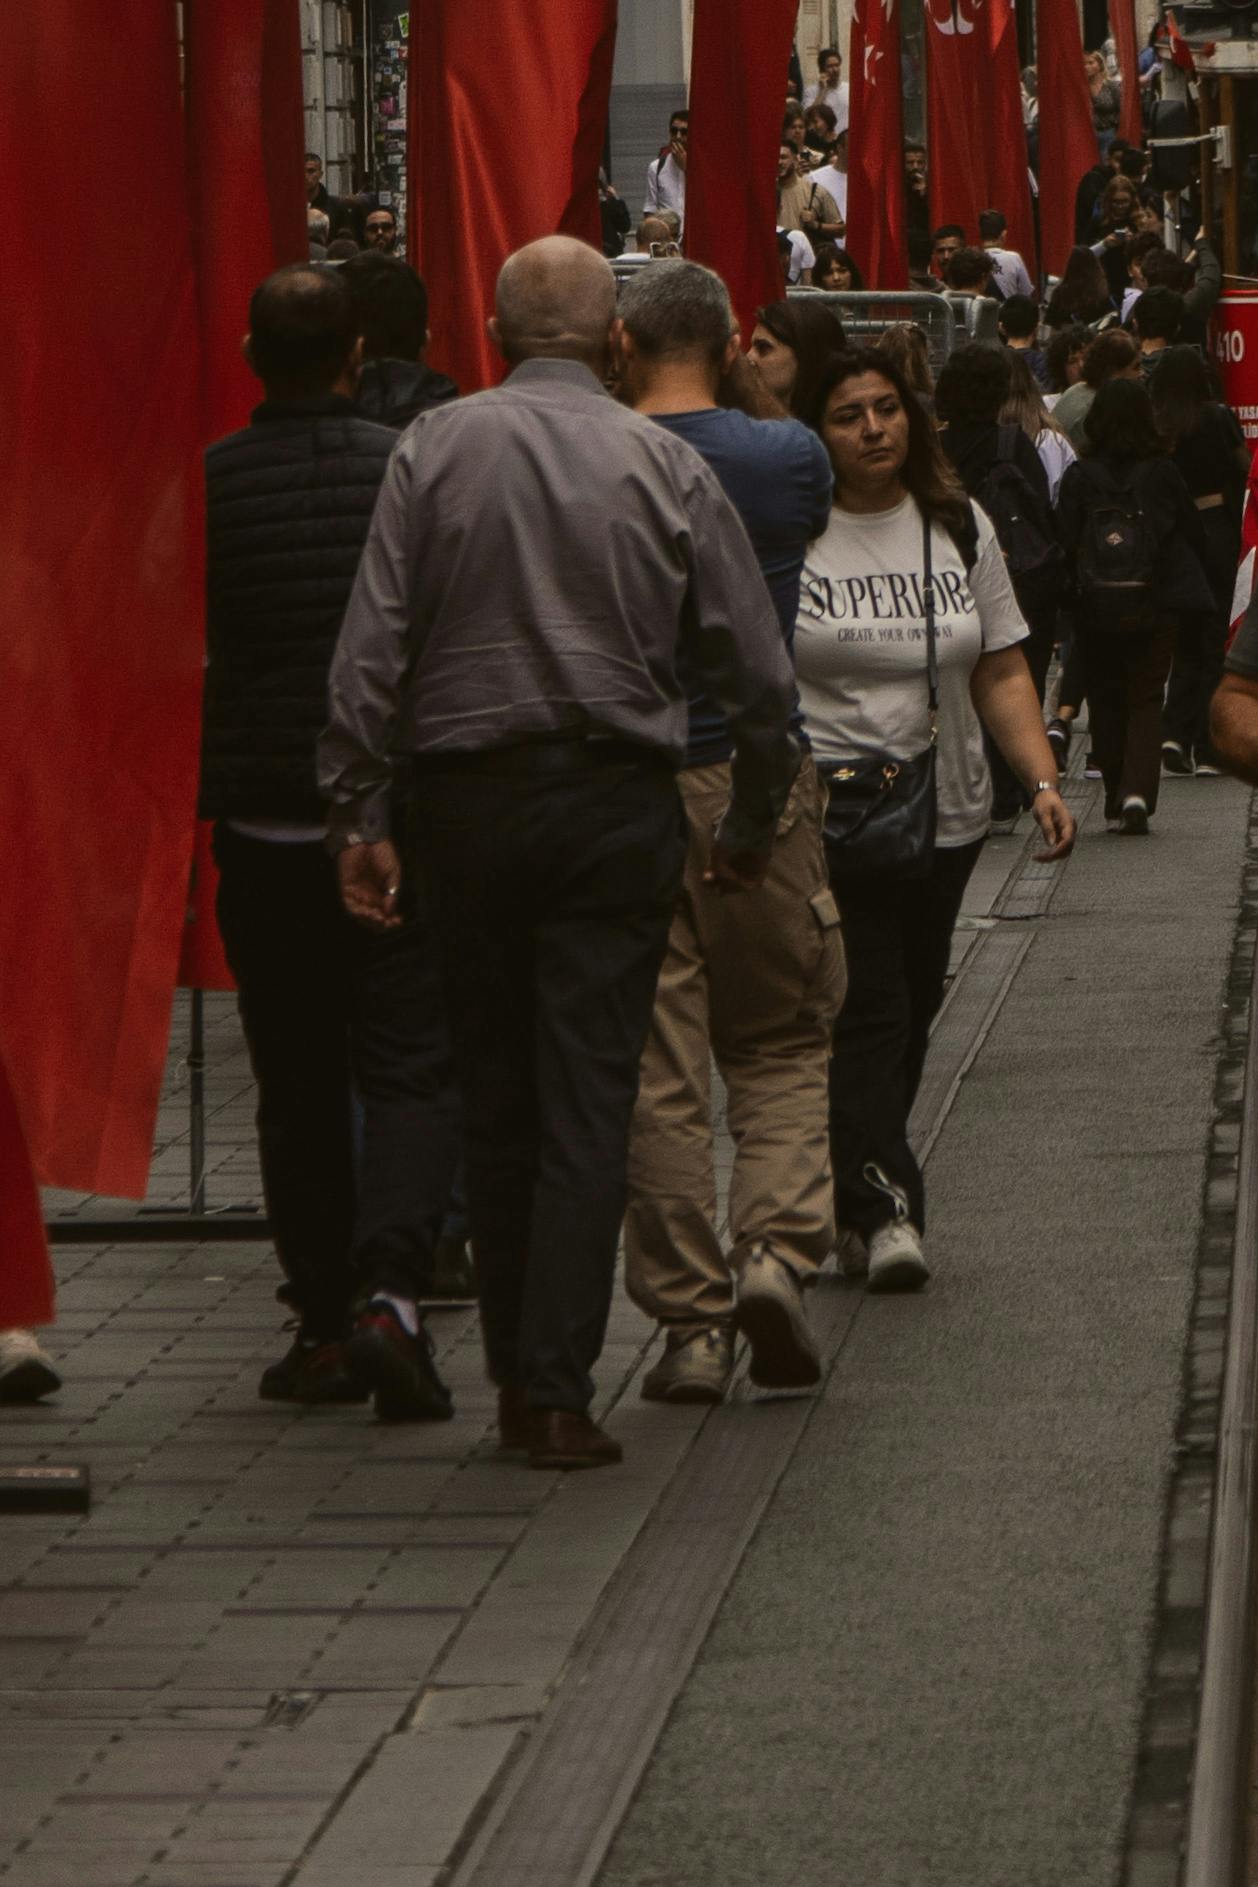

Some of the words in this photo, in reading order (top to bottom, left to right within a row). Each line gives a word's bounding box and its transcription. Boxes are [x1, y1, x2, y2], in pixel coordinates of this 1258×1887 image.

[806, 571, 976, 620] SUPERIOR
[837, 628, 876, 642] CREATE
[877, 627, 904, 642] YOUR
